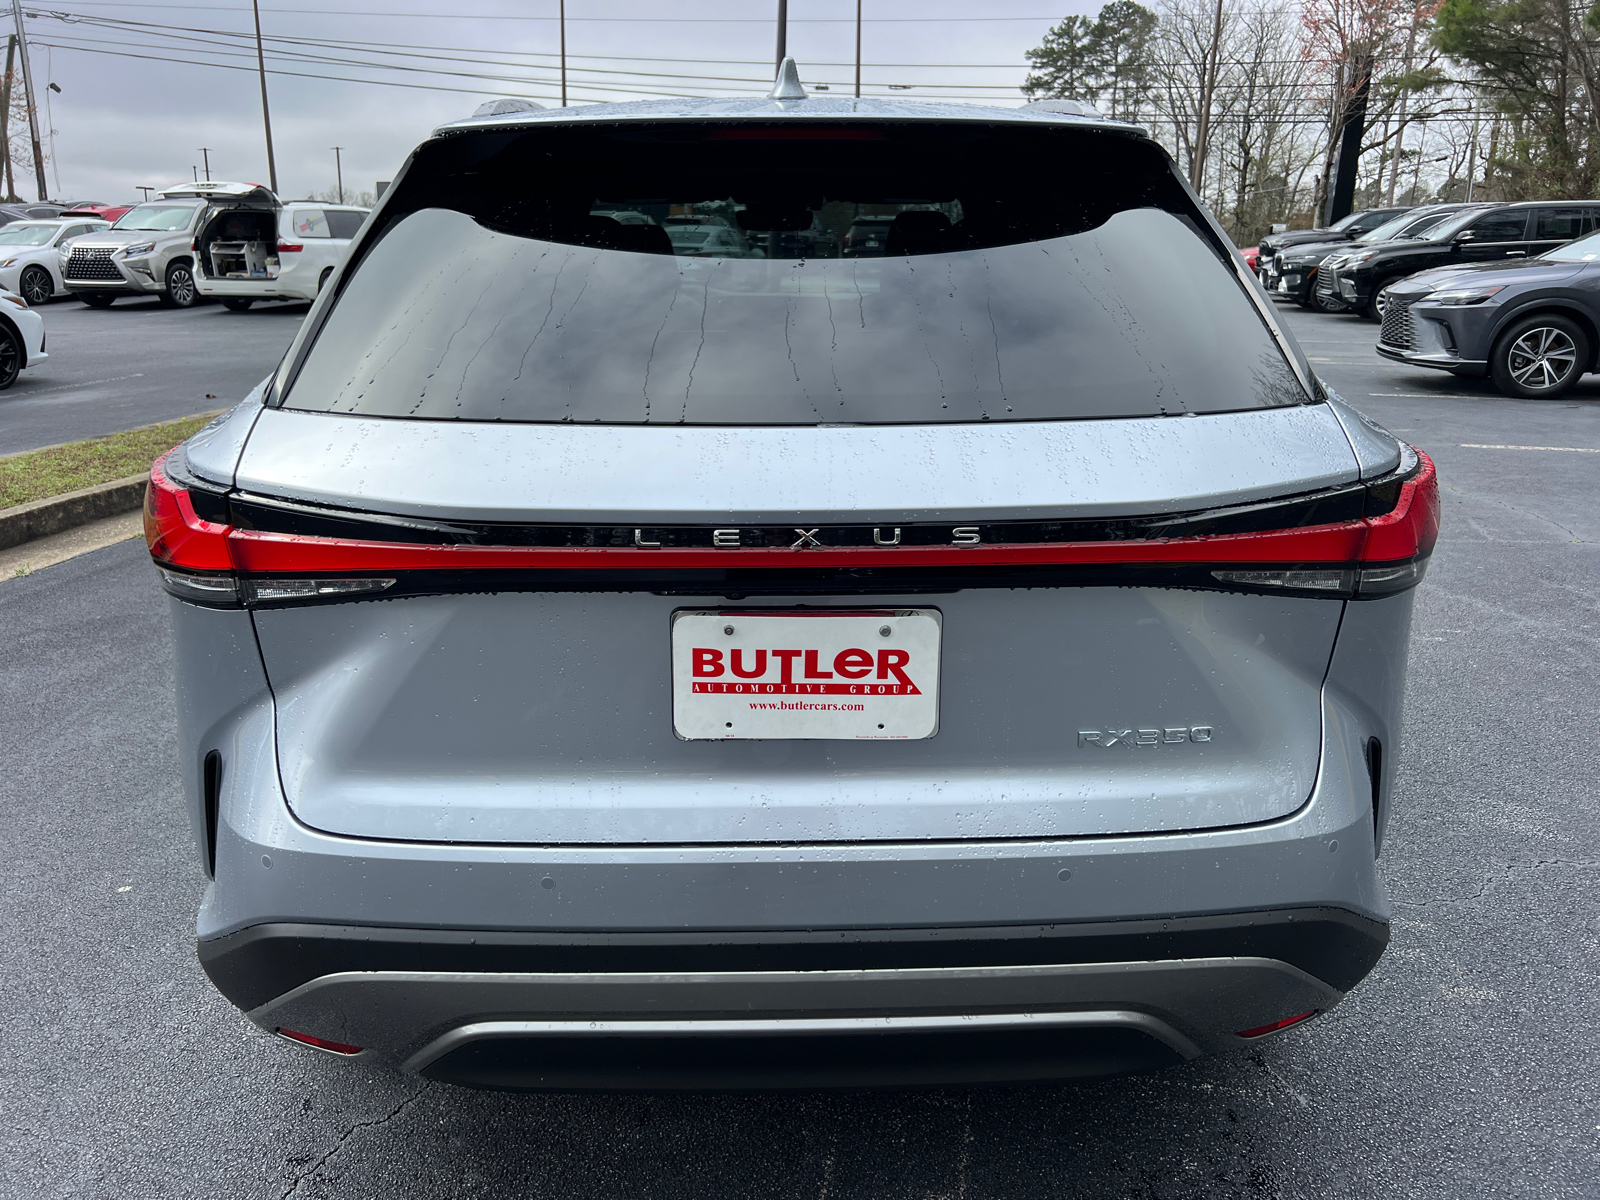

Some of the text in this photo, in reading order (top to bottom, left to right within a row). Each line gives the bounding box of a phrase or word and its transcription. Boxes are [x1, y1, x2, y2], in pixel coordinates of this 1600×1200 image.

[634, 527, 981, 547] LEXUS
[693, 683, 914, 695] AUTOMOTIVE GROUP
[749, 701, 865, 711] www.butlercars.com
[1077, 726, 1214, 748] RX350
